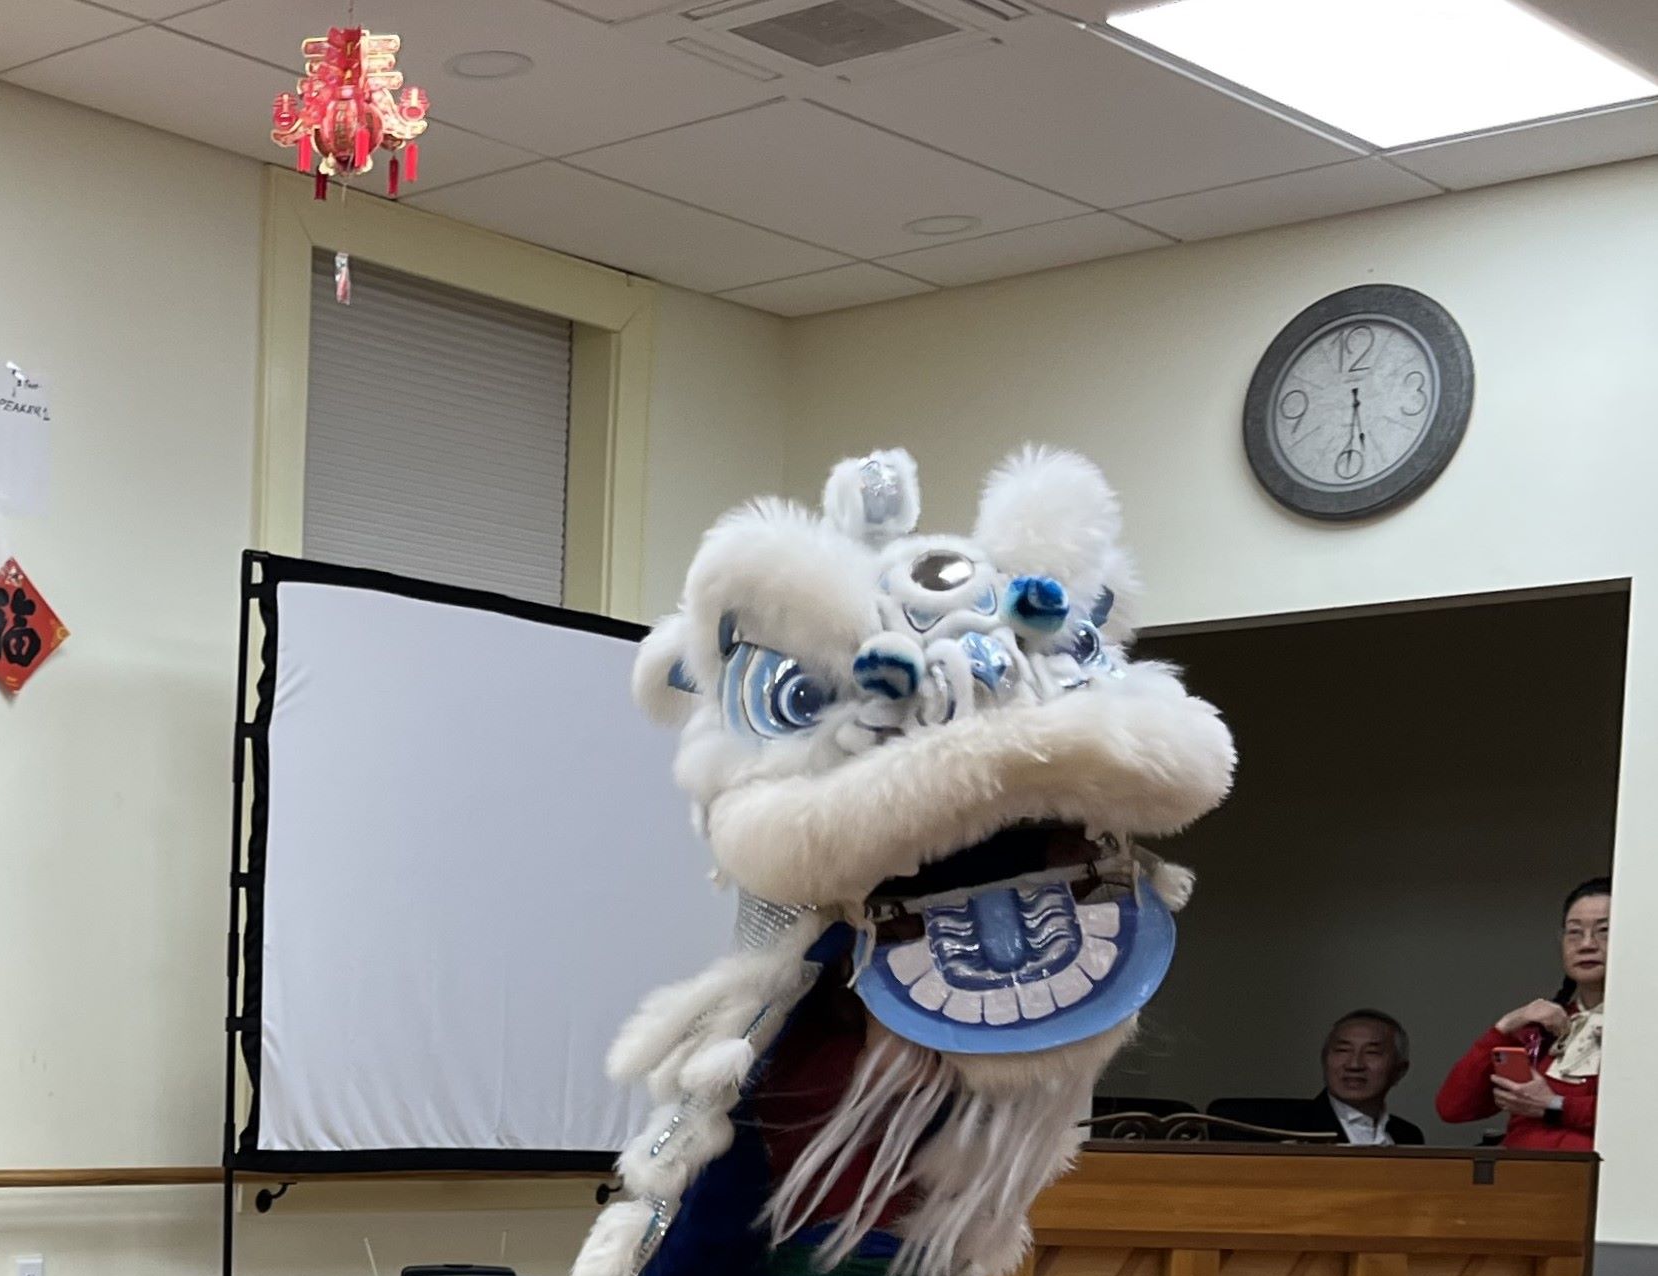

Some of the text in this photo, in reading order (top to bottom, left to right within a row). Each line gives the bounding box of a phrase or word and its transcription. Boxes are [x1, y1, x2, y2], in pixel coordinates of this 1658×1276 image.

[1330, 325, 1375, 373] 12
[1280, 390, 1309, 434] 9
[1400, 371, 1427, 416] 3
